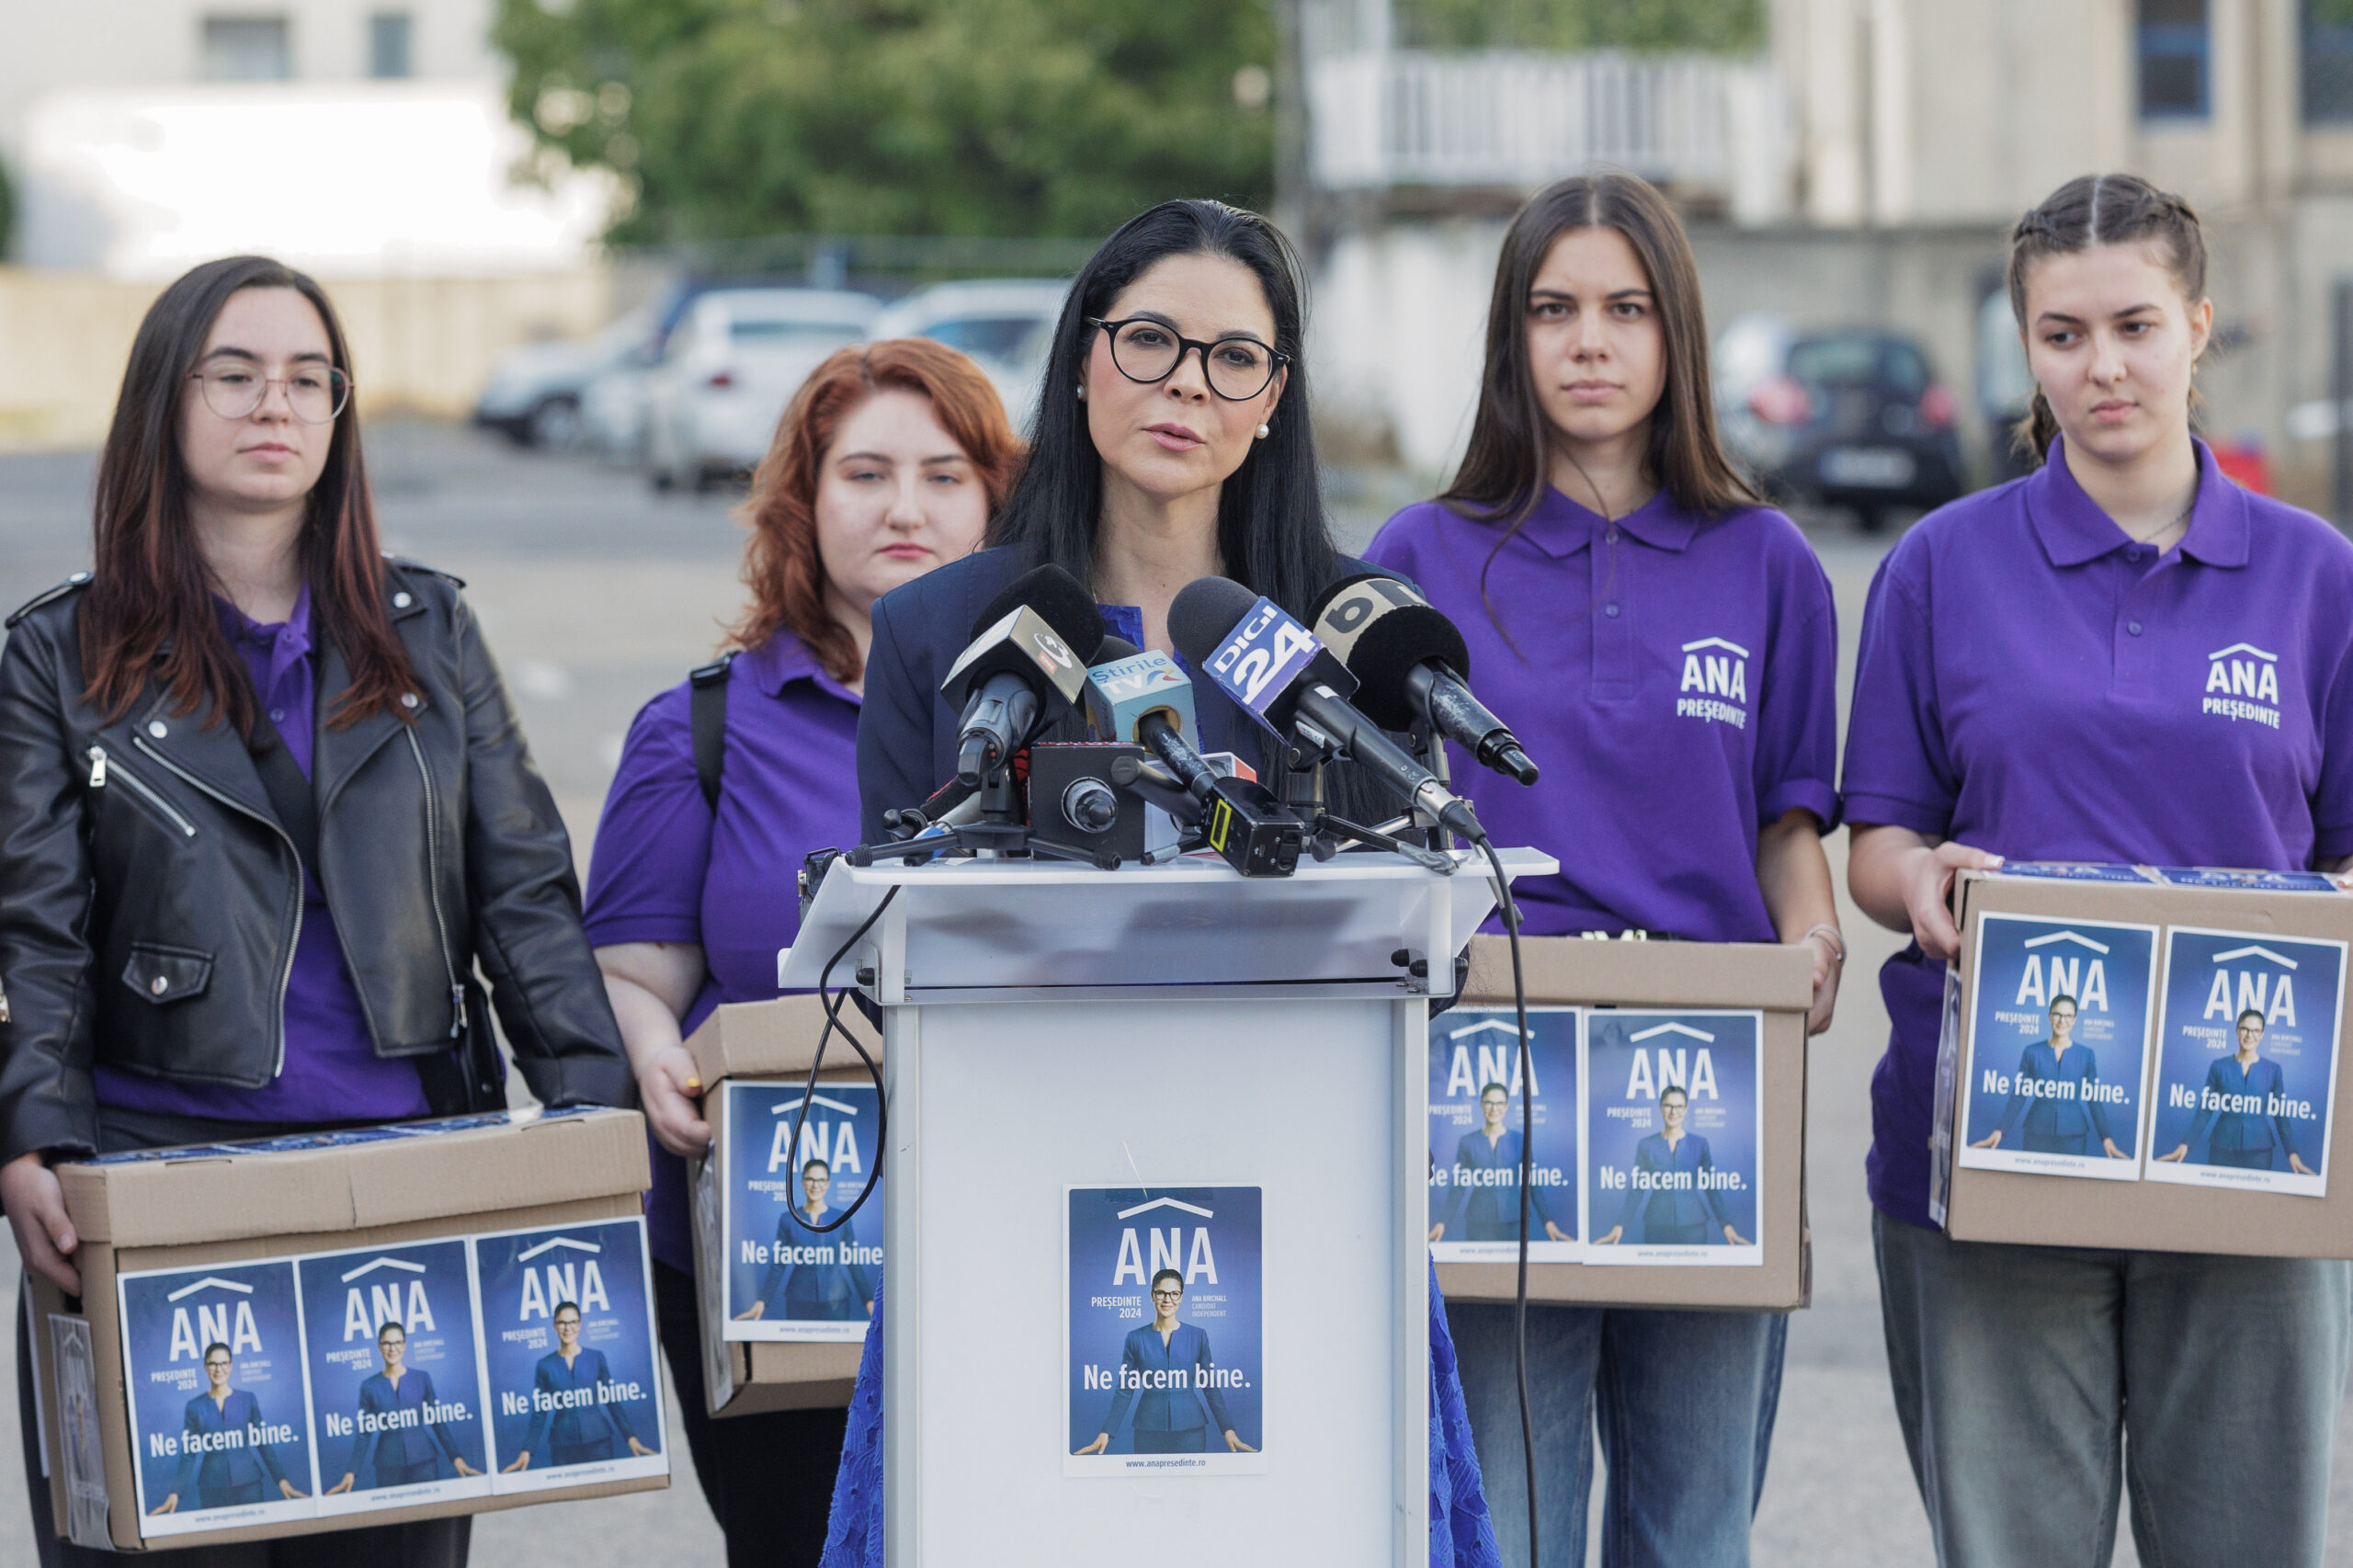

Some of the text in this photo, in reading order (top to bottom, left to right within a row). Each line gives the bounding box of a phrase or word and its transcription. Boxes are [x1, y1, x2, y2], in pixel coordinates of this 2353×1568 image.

[1213, 605, 1278, 674] DIGI
[1233, 620, 1316, 705] 24
[1680, 653, 1746, 704] ANA
[2206, 659, 2279, 705] ANA
[2202, 697, 2280, 730] PREȘEDINTE
[2016, 954, 2109, 1012] ANA
[2203, 969, 2296, 1028] ANA
[2018, 1024, 2040, 1035] 2024
[2206, 1039, 2227, 1050] 2024
[1447, 1045, 1540, 1096] ANA
[1626, 1048, 1719, 1100] ANA
[1984, 1069, 2130, 1105] Ne facem bine.
[2169, 1084, 2316, 1120] Ne facem bine.
[767, 1120, 862, 1174] ANA
[1452, 1162, 1513, 1187] facem
[1600, 1165, 1747, 1190] Ne facem bine.
[773, 1191, 788, 1202] 202
[742, 1240, 883, 1266] Ne facem bine
[1113, 1227, 1218, 1286] ANA
[519, 1260, 610, 1321] ANA
[1091, 1296, 1142, 1310] PREȘEDINTE
[344, 1279, 436, 1342] ANA
[1120, 1308, 1142, 1318] 2024
[169, 1301, 263, 1362] ANA
[177, 1380, 198, 1391] 2024
[1084, 1362, 1251, 1390] Ne facem bine.
[502, 1379, 647, 1416] Ne facem bine.
[325, 1400, 473, 1437] Ne facem bine.
[150, 1421, 300, 1458] Ne facem bine.
[1126, 1458, 1206, 1469] www.anapresedinte.ro
